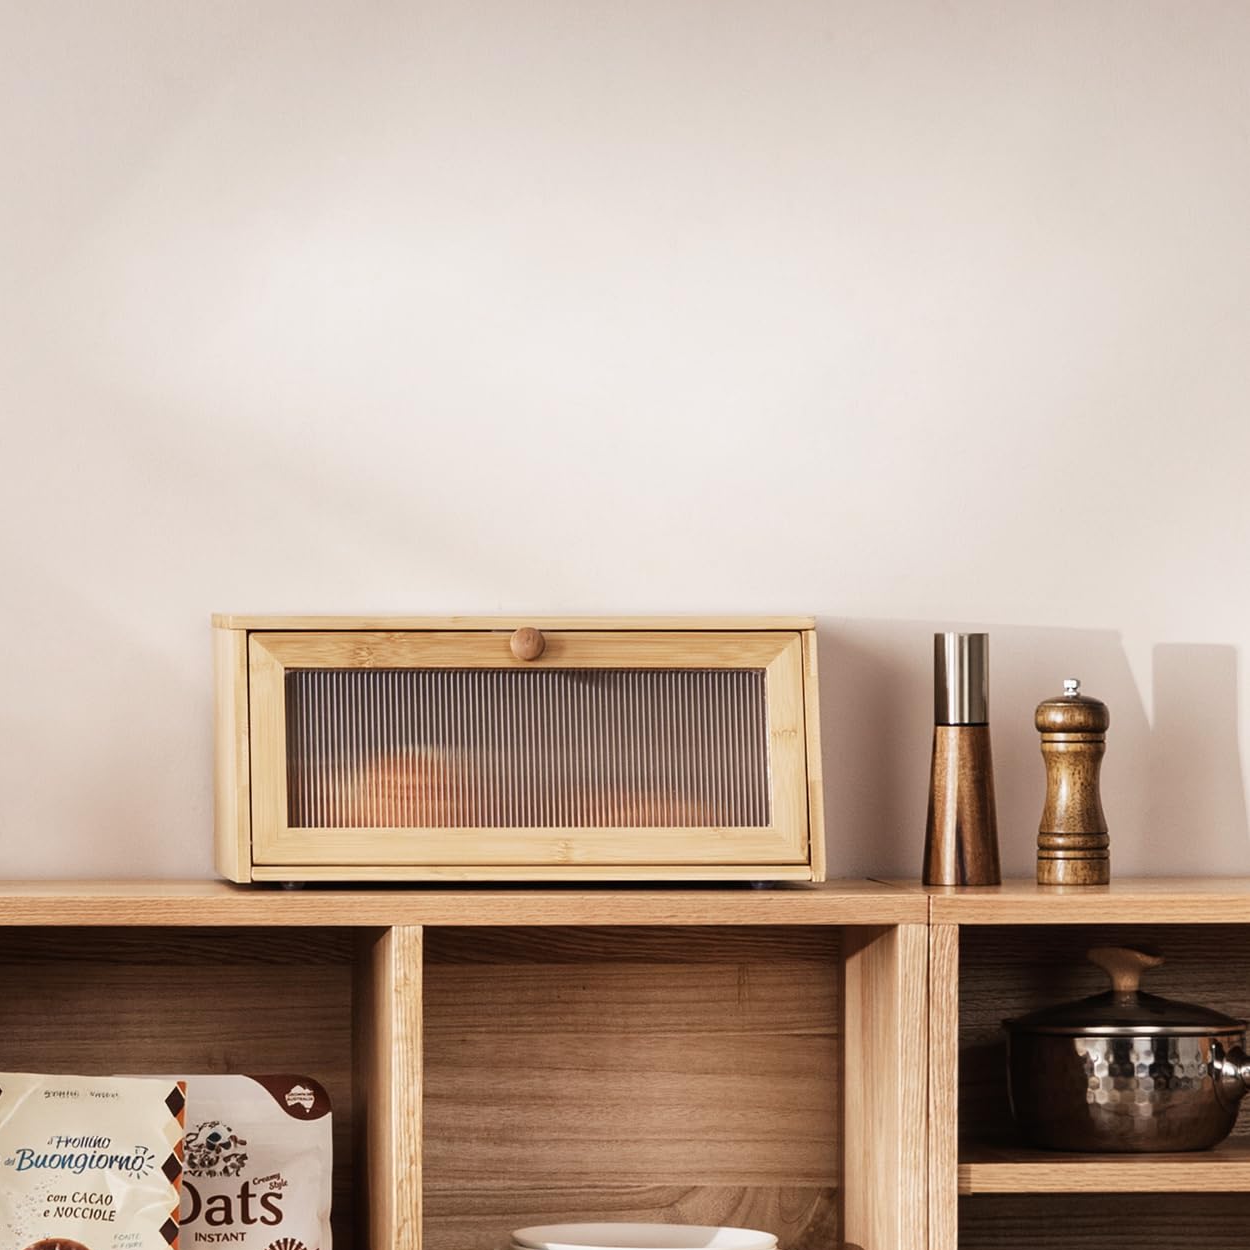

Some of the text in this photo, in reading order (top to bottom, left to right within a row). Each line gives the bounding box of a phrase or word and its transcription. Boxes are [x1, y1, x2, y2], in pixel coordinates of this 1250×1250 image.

[54, 1136, 111, 1149] Frollino
[15, 1148, 144, 1174] Buongiorno
[252, 1173, 281, 1185] Creamy
[268, 1179, 288, 1190] Style
[47, 1192, 113, 1206] con CACAO
[43, 1206, 116, 1222] e NOCCIOLE
[195, 1232, 246, 1242] INSTANT
